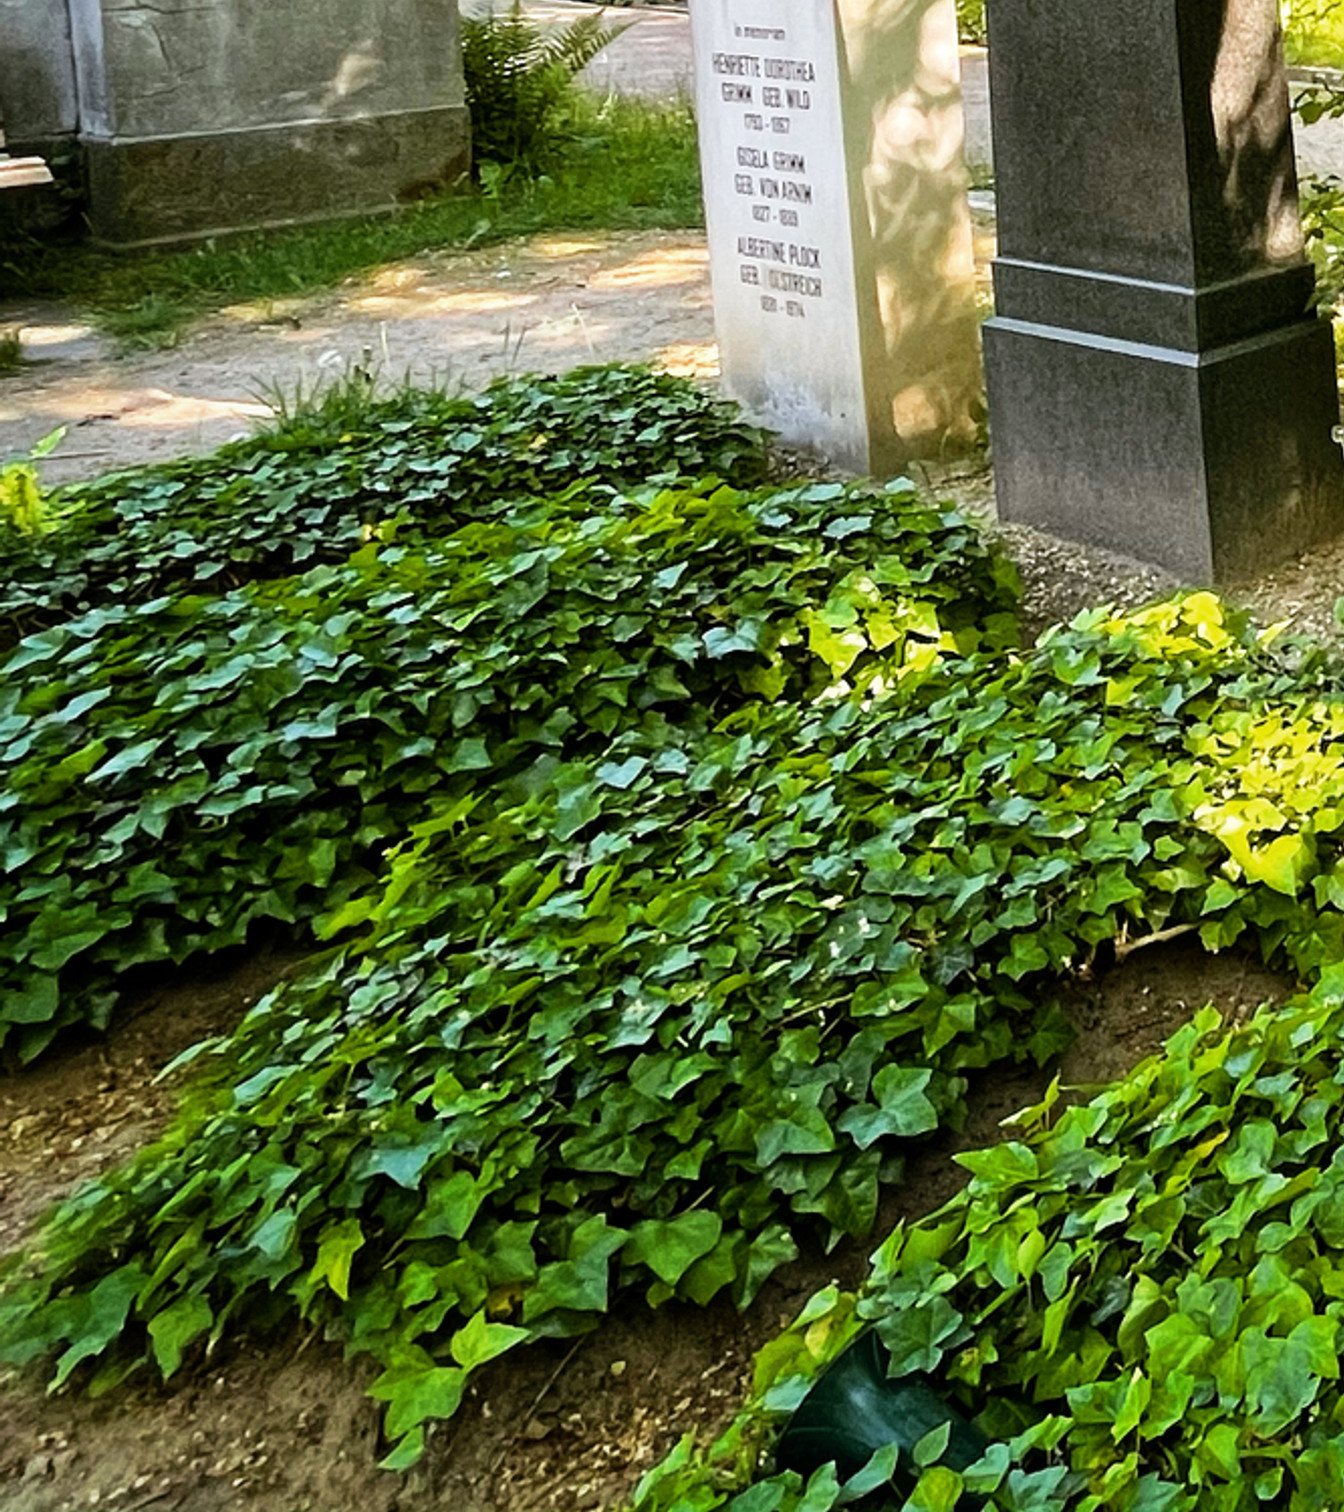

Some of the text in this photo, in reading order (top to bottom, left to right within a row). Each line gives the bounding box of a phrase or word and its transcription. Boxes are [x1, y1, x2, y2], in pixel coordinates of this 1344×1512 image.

[712, 53, 760, 78] HENRIETTE
[773, 151, 805, 174] GRIMM
[738, 237, 786, 264] ALBERTINE
